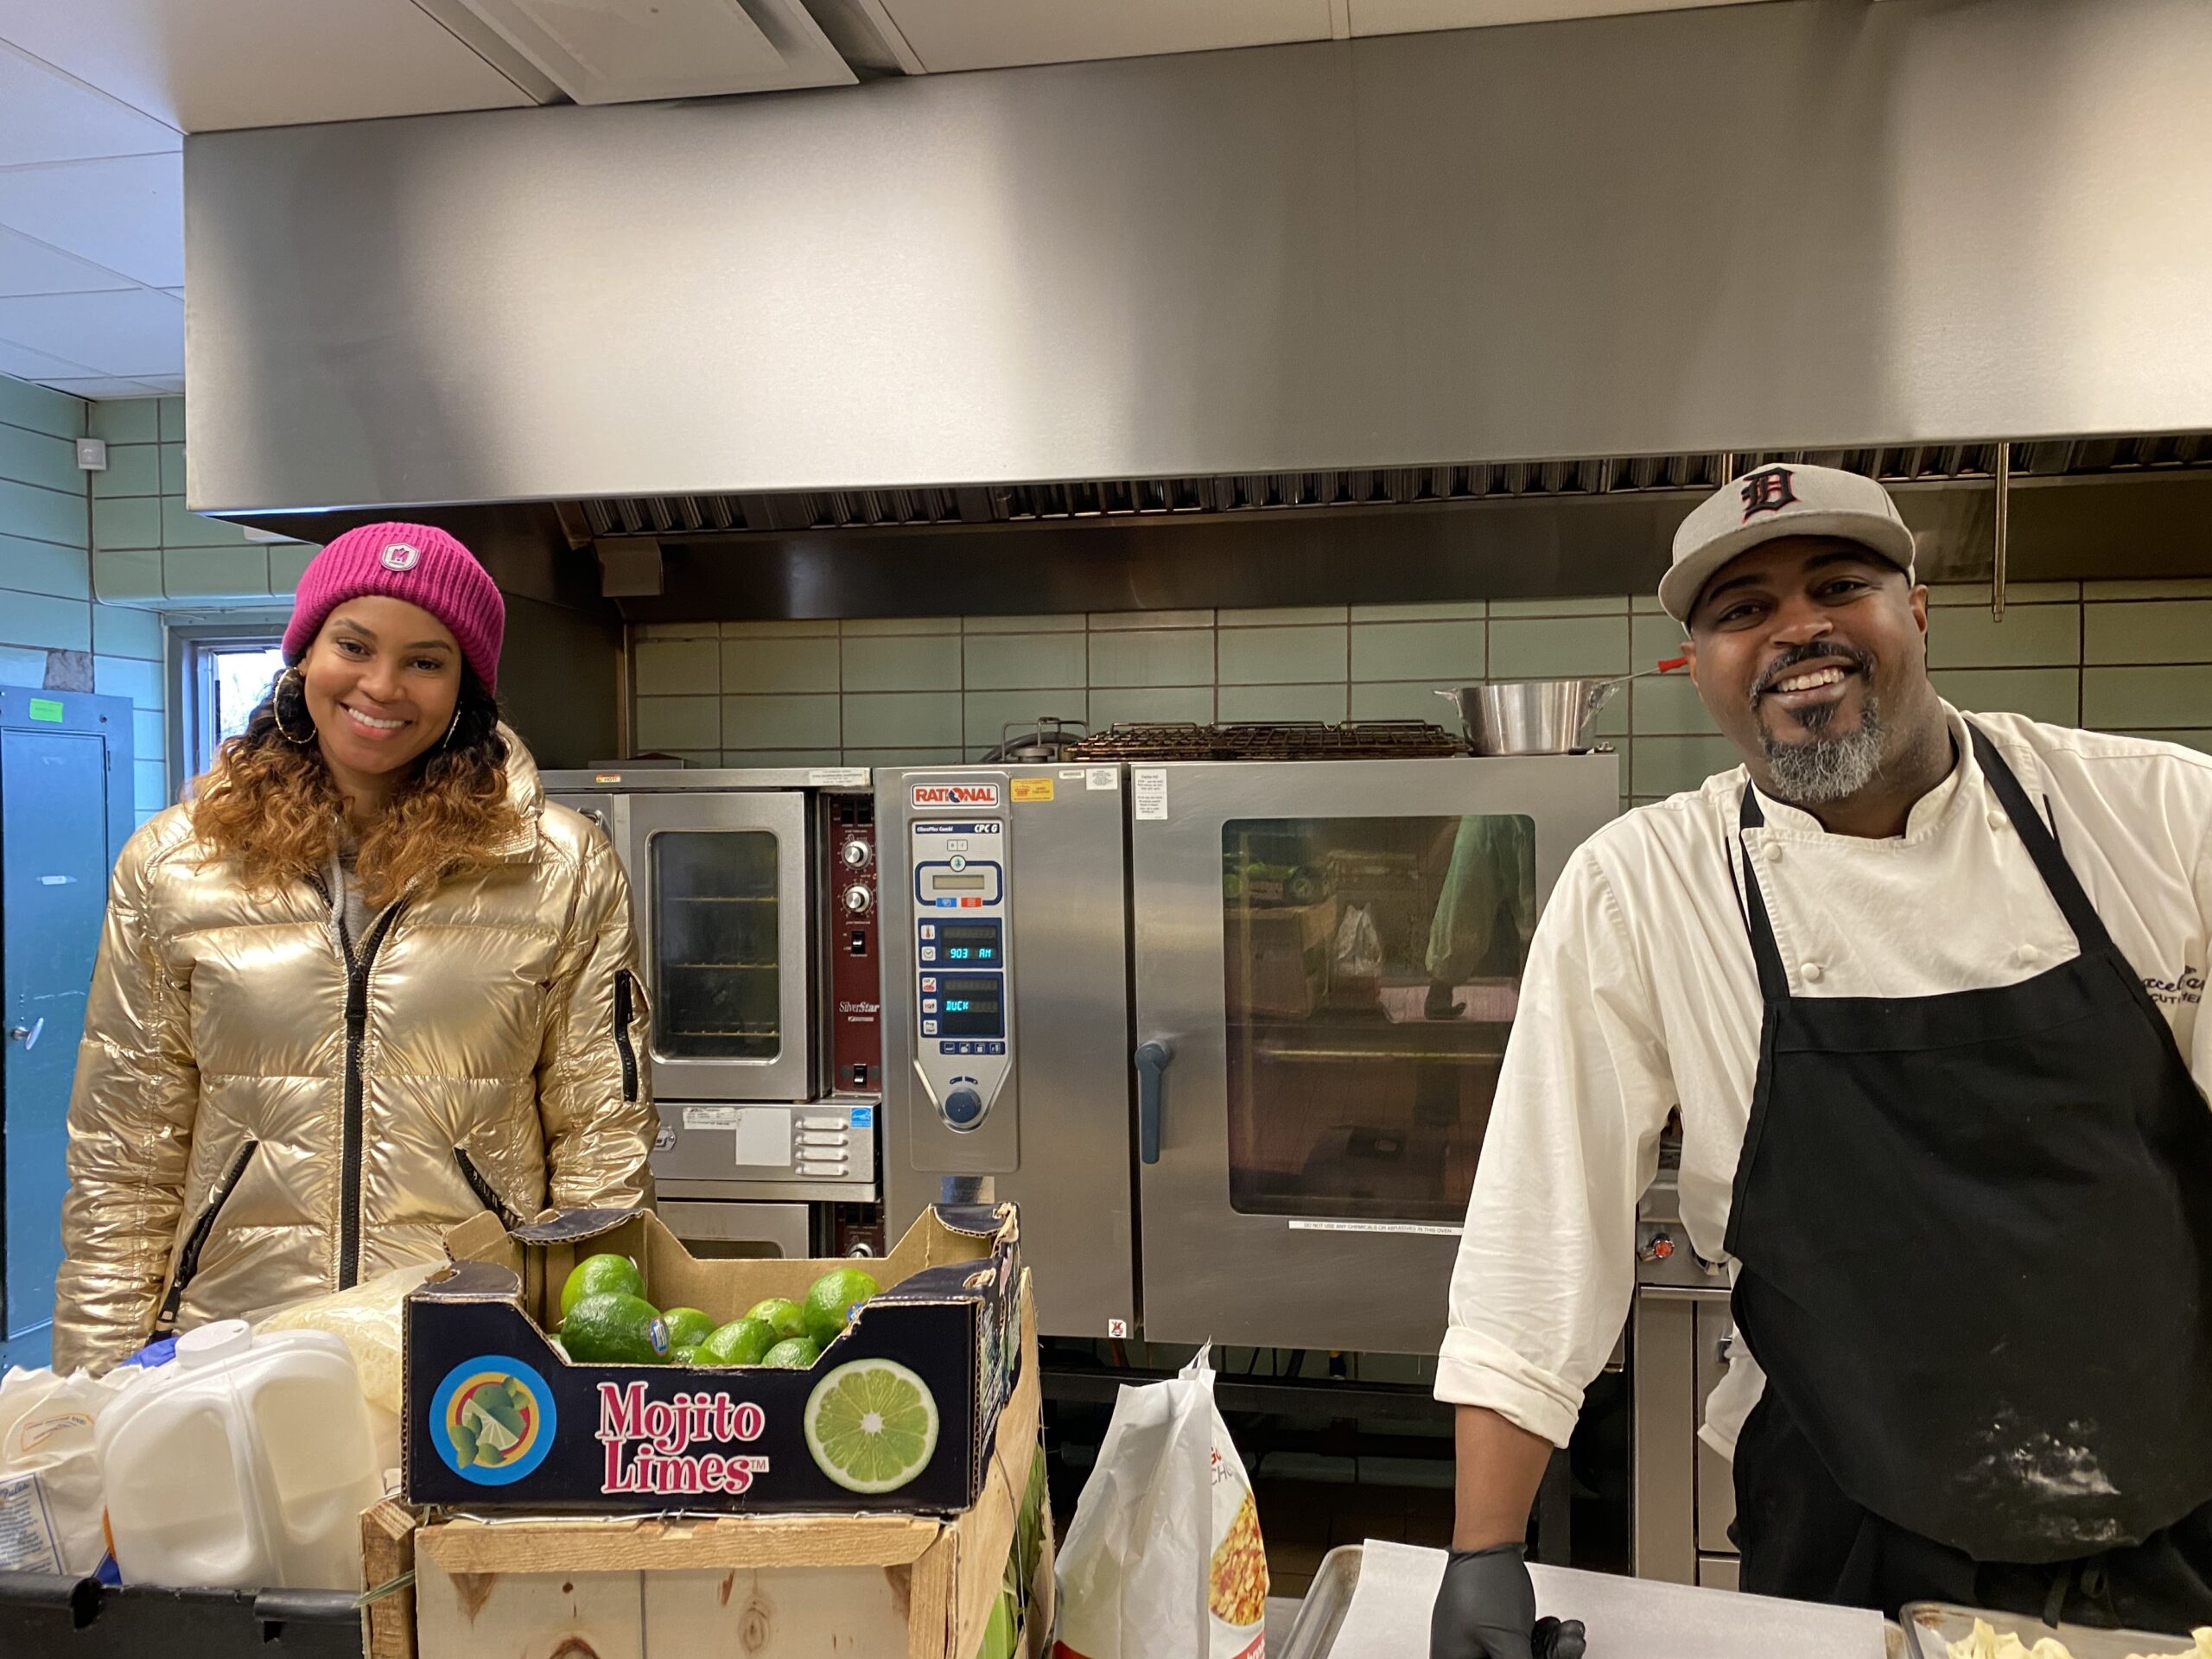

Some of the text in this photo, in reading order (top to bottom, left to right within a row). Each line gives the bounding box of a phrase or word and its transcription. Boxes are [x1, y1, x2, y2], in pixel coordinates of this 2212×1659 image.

[1740, 466, 1801, 524] D
[915, 787, 995, 804] RATIONAL
[974, 823, 990, 833] CPC
[990, 823, 998, 833] G
[950, 948, 993, 959] 903 AM
[839, 1001, 880, 1013] SilverStar
[945, 1001, 969, 1012] DUCK
[594, 1381, 766, 1455] Mojito
[601, 1435, 753, 1495] Limes
